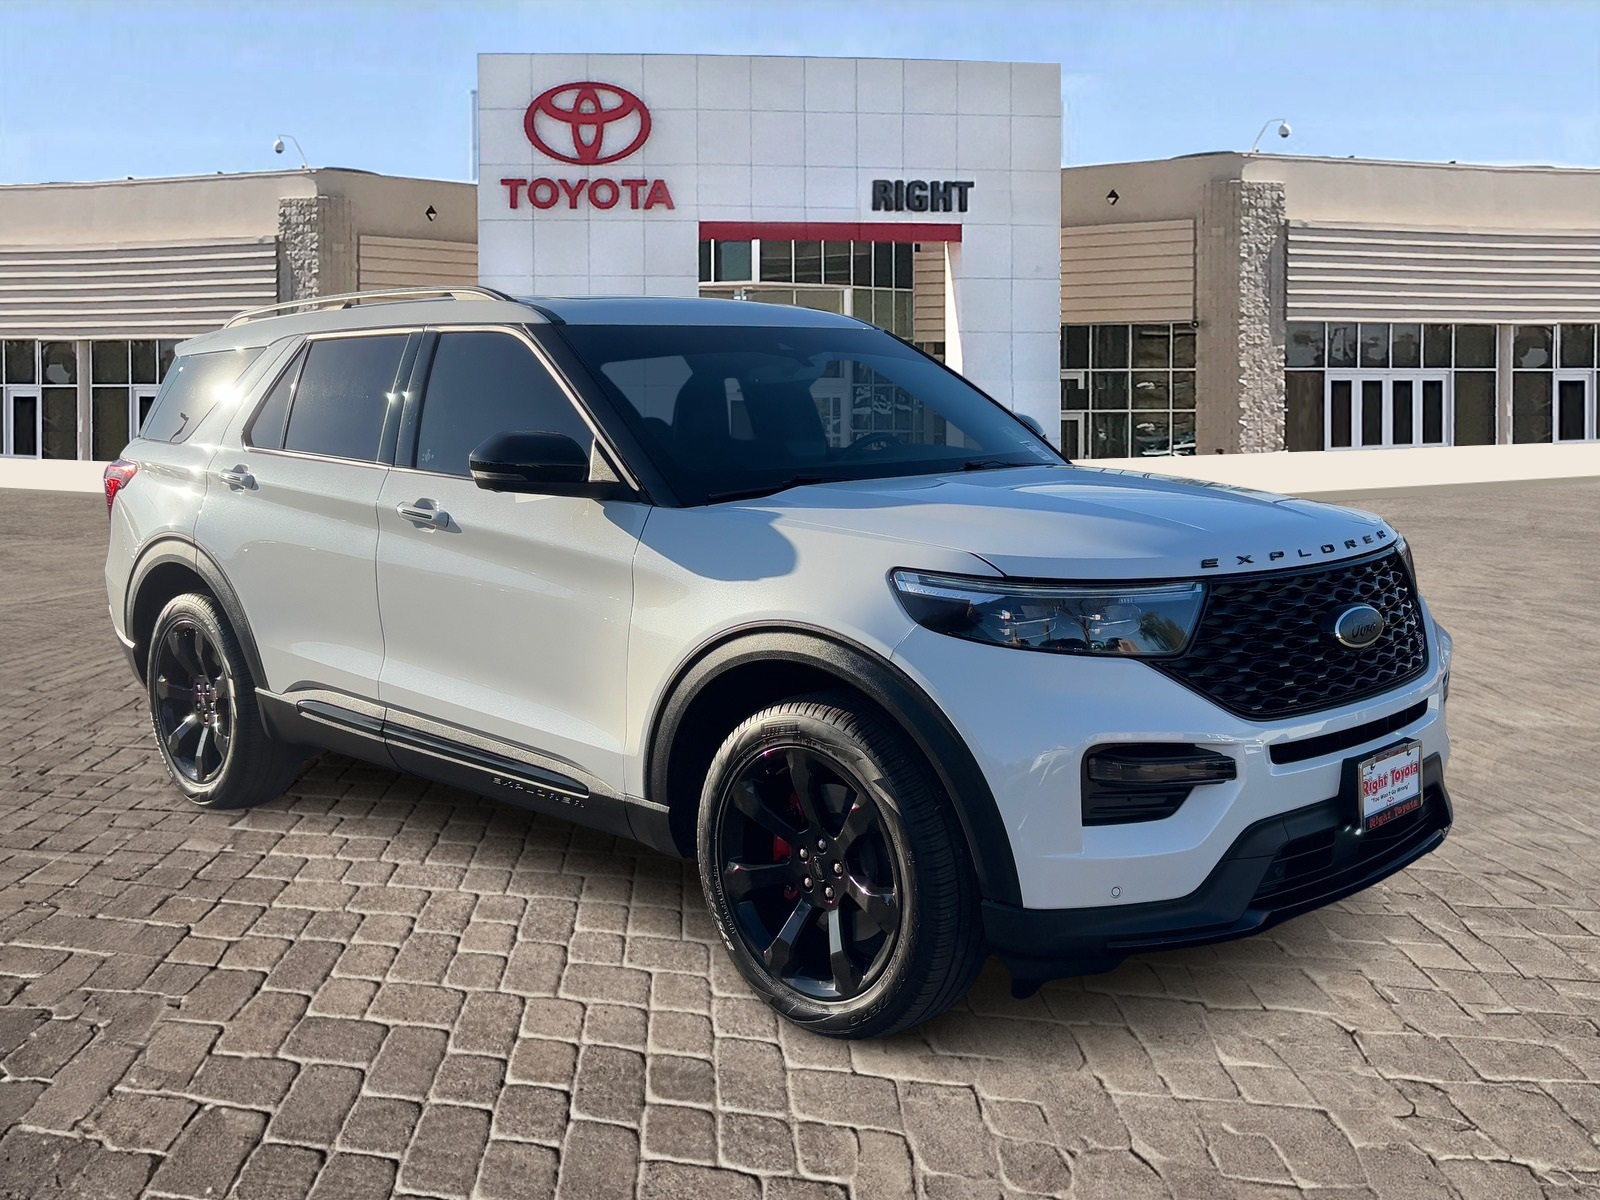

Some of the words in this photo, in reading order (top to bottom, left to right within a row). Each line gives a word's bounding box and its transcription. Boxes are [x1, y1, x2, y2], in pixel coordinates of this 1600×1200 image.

[500, 178, 675, 210] TOYOTA
[872, 179, 975, 213] RIGHT
[1200, 529, 1388, 569] EXPLORER
[492, 777, 585, 808] EXPLORER
[1363, 774, 1388, 796] Right
[1390, 761, 1419, 787] Toyota
[1370, 811, 1392, 828] Right
[1394, 799, 1419, 817] Toyota
